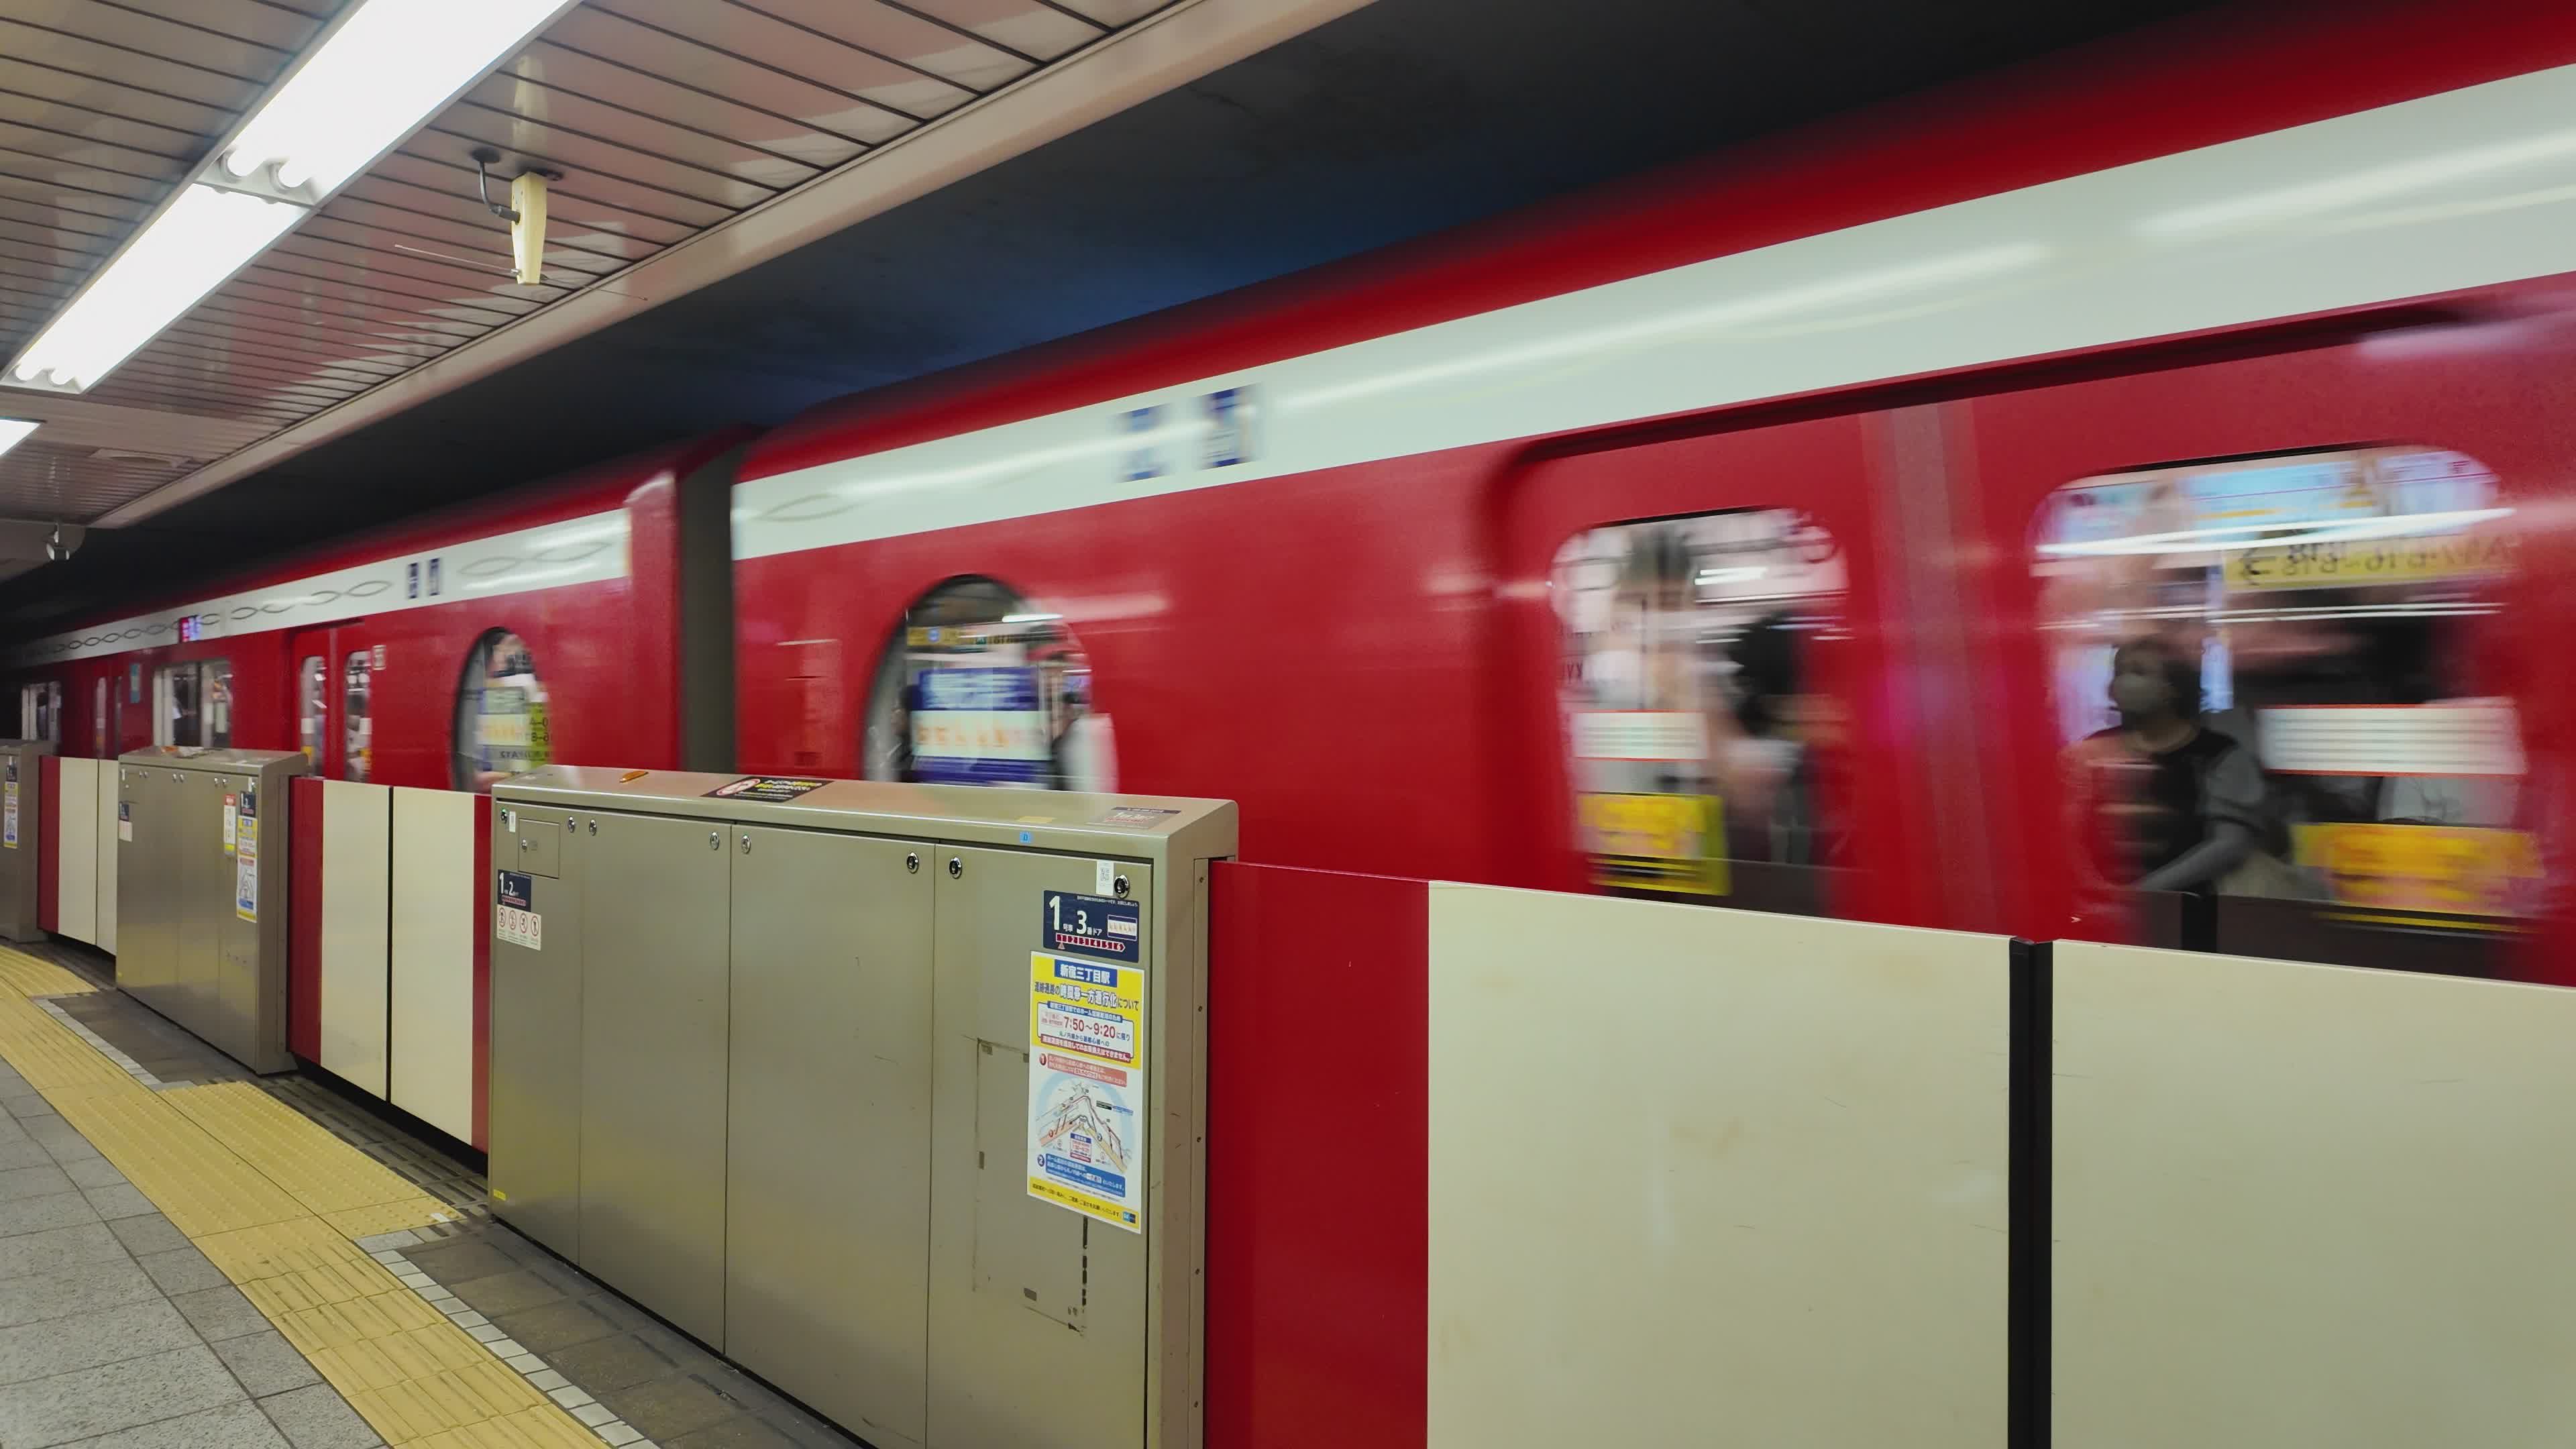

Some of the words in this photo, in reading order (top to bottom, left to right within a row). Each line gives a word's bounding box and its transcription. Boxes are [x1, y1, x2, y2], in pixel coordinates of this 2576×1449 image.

[499, 872, 504, 894] 1
[508, 881, 514, 896] 2
[1049, 895, 1060, 931] 1
[1076, 910, 1087, 934] 3
[1060, 963, 1110, 985] 新宿三丁目駅
